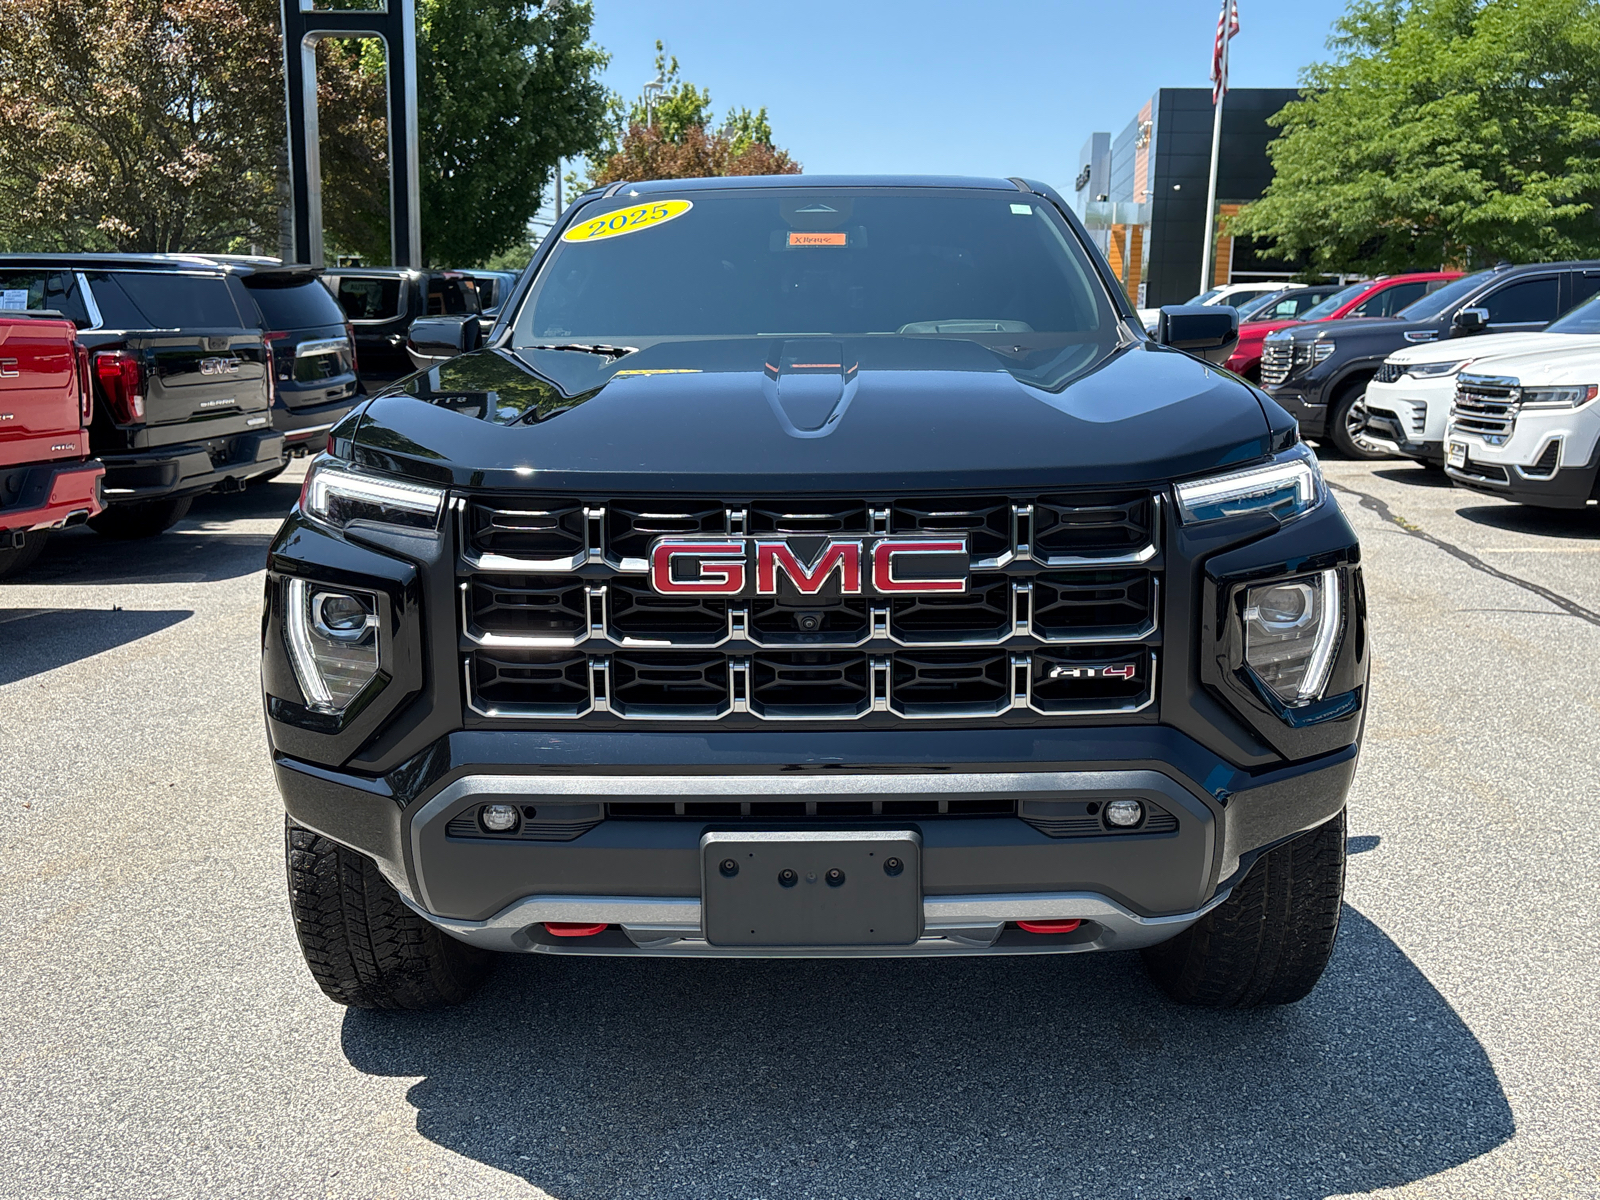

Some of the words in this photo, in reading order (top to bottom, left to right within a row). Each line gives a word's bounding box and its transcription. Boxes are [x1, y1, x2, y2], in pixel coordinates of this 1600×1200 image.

[588, 203, 668, 237] 2025
[200, 358, 239, 376] GMC
[651, 538, 967, 596] GMC
[1049, 664, 1135, 681] AT4
